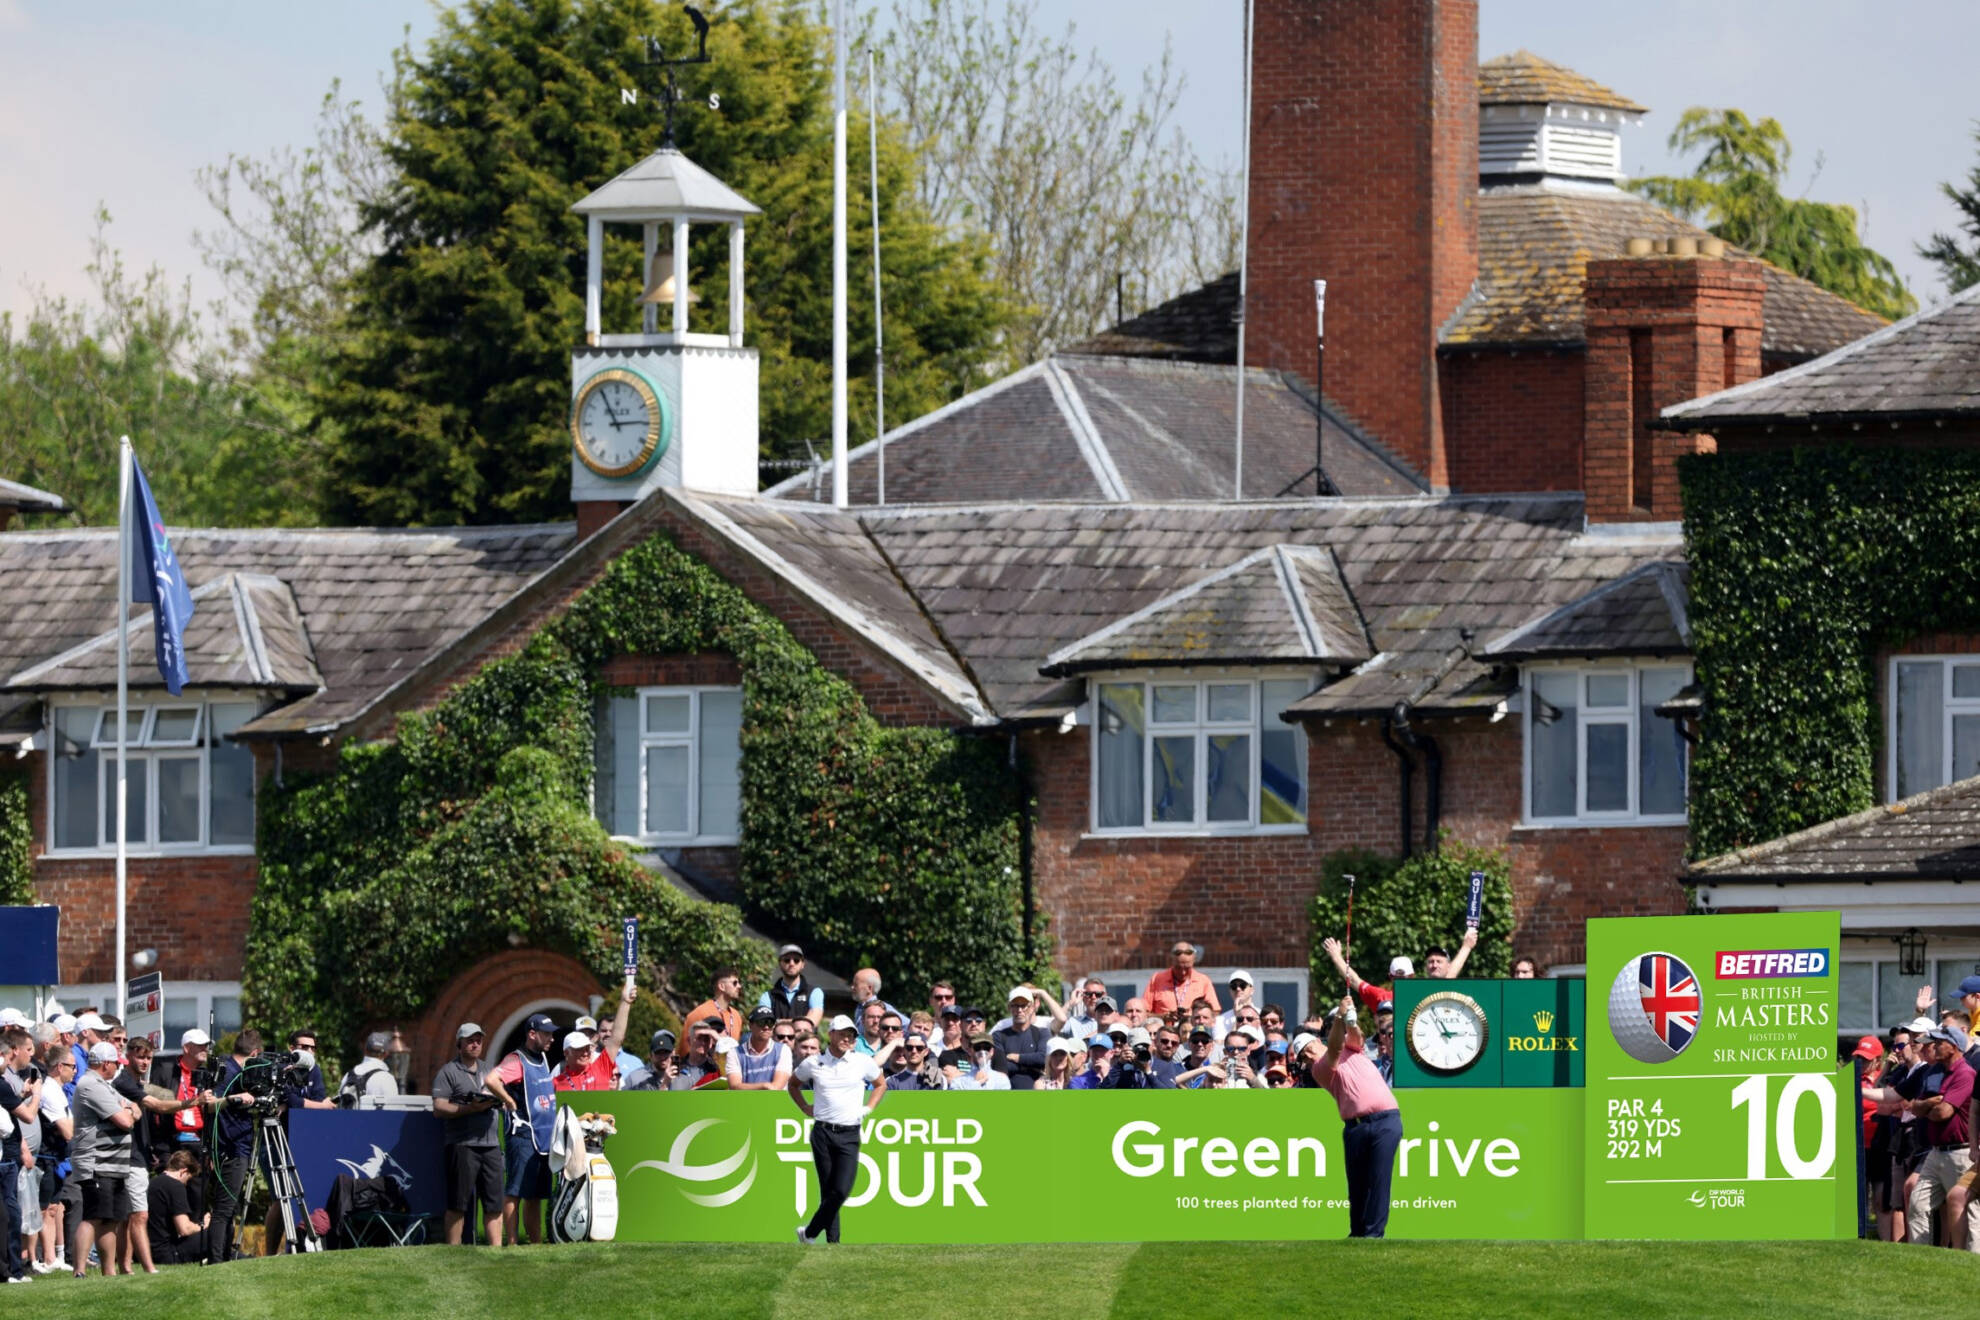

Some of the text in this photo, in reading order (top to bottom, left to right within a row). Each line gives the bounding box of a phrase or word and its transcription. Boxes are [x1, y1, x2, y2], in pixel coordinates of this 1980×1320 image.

[621, 88, 637, 105] N
[708, 92, 720, 110] S
[1471, 878, 1480, 916] QUIET
[626, 925, 635, 964] QUIET
[1719, 952, 1825, 975] BETFRED
[1741, 986, 1802, 1000] BRITISH
[1715, 1003, 1829, 1028] MASTERS
[1508, 1036, 1578, 1051] ROLEX
[1749, 1032, 1798, 1042] HOSTED BY
[1713, 1046, 1828, 1062] SIR NICK FALDO
[1608, 1098, 1663, 1117] PAR 4
[1607, 1118, 1681, 1138] 319 YDS
[1731, 1073, 1837, 1180] 10
[1111, 1120, 1521, 1178] Green rive
[1607, 1140, 1662, 1159] 292 M
[776, 1151, 989, 1219] TOUR
[1175, 1196, 1351, 1212] 100 trees planted for eve
[1412, 1196, 1457, 1209] driven
[1709, 1195, 1746, 1209] TOUR
